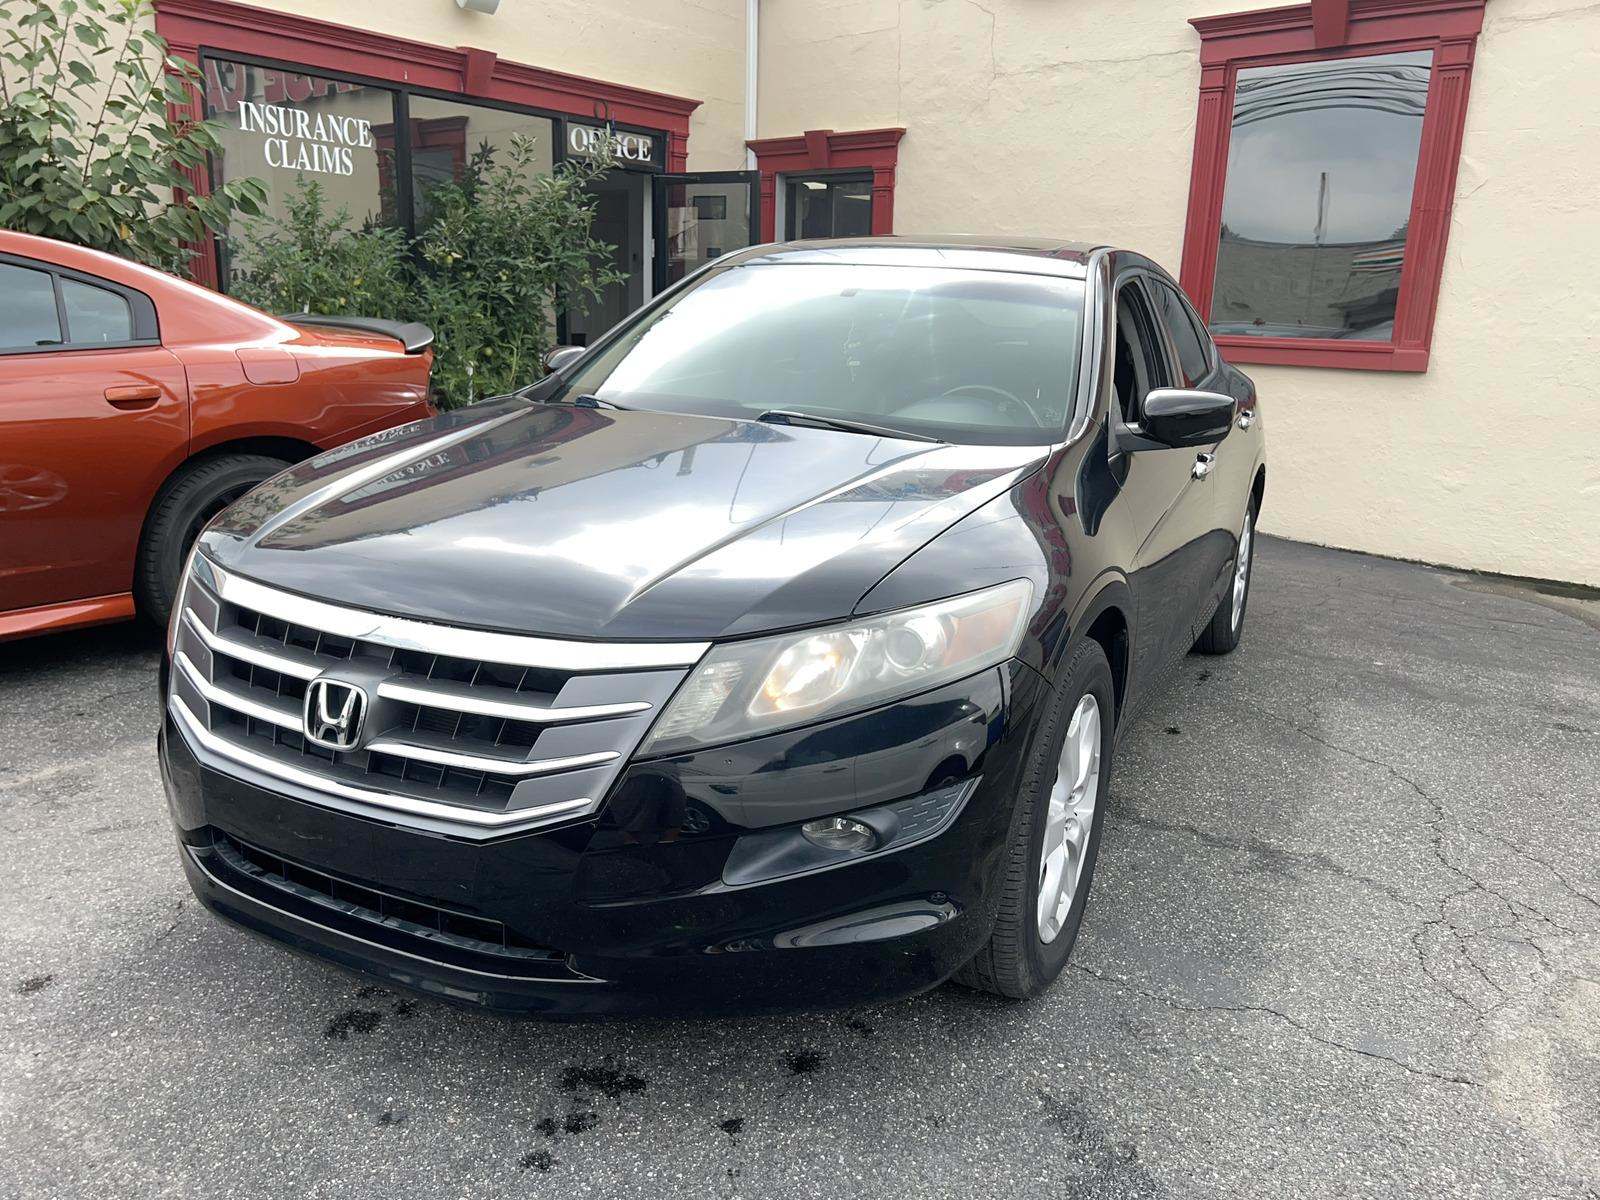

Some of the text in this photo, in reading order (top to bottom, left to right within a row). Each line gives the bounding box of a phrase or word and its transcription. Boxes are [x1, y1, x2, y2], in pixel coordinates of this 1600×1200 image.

[237, 100, 373, 148] INSURANCE
[264, 137, 354, 176] CLAIMS
[570, 127, 653, 162] OFICE
